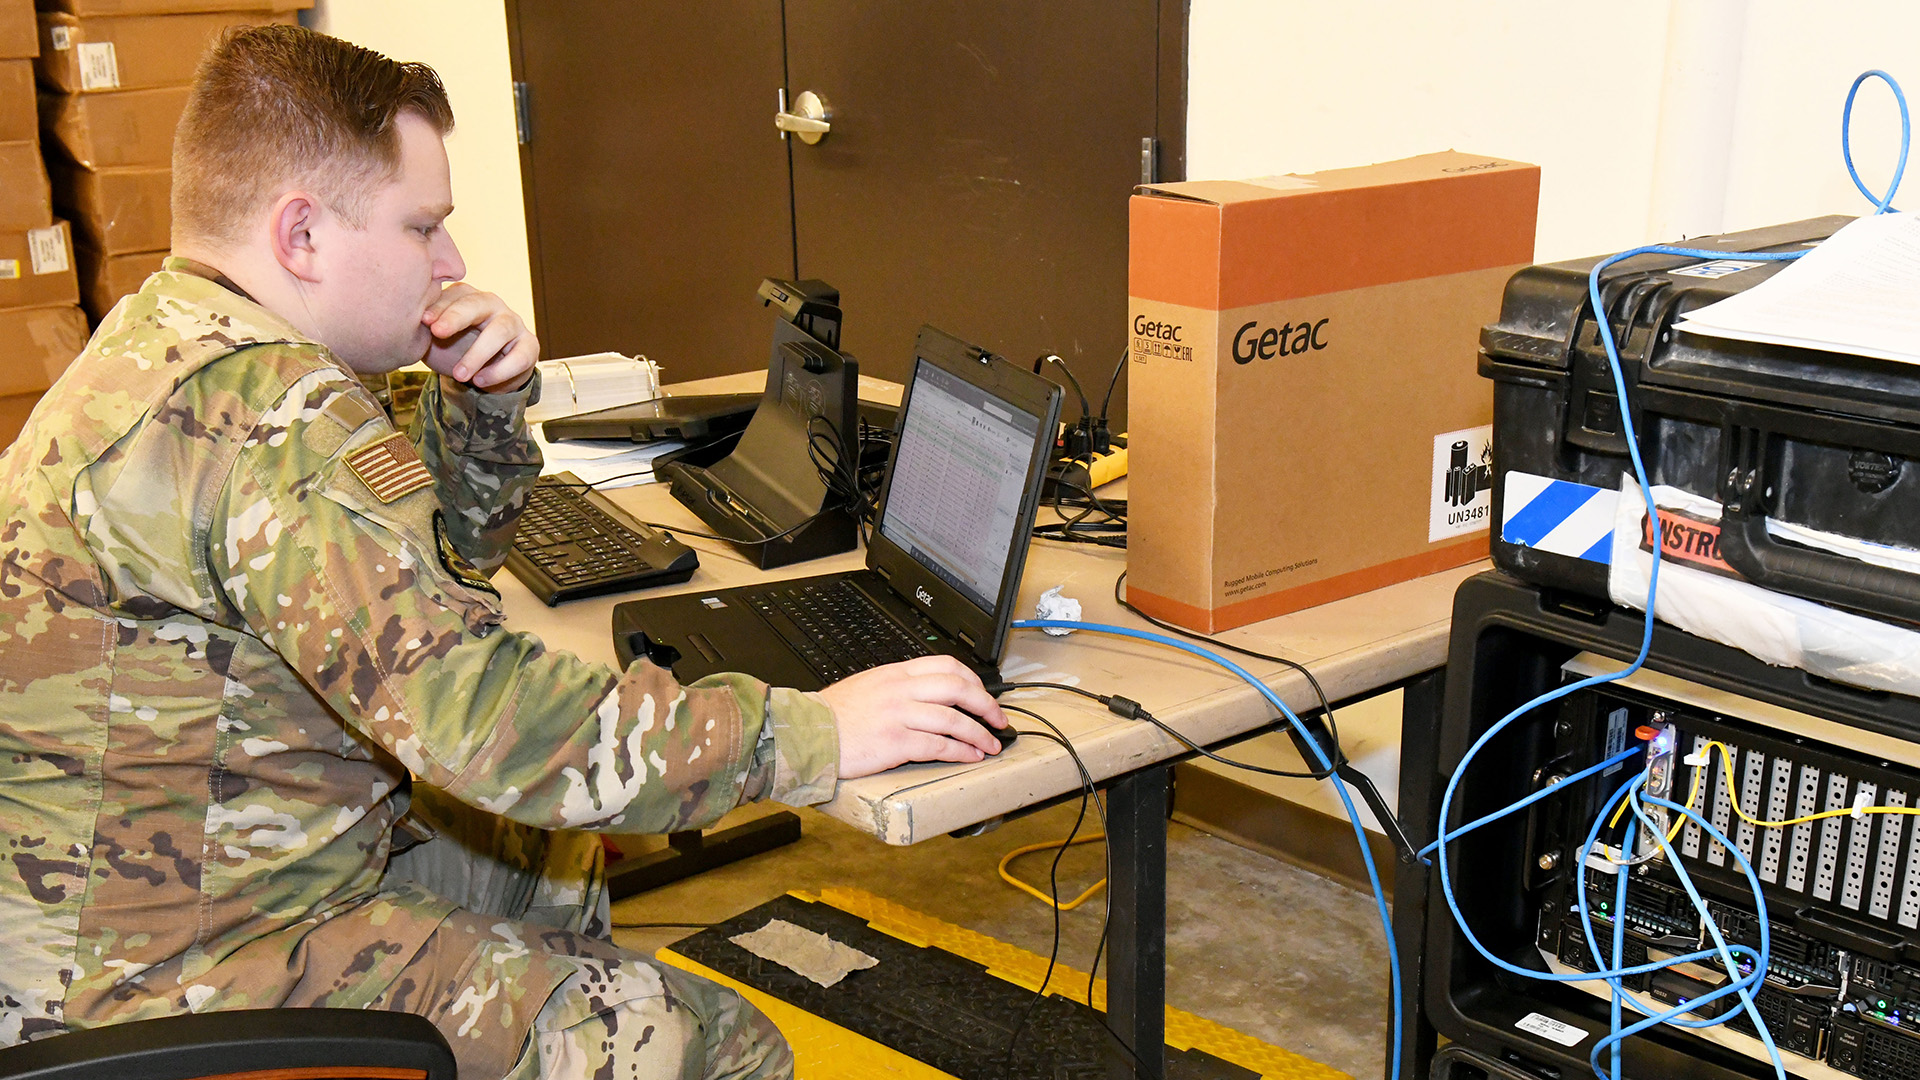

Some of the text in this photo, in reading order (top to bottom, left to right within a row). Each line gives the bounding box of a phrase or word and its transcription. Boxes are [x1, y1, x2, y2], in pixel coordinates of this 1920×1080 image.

[1134, 314, 1182, 342] Getac
[1232, 317, 1330, 366] Getac
[1448, 504, 1489, 525] UN3481
[1652, 516, 1723, 560] NSTR
[1224, 558, 1318, 588] Rugged Mobile Computing Solutions
[916, 585, 934, 607] Getac
[1224, 581, 1267, 597] www.getac.com
